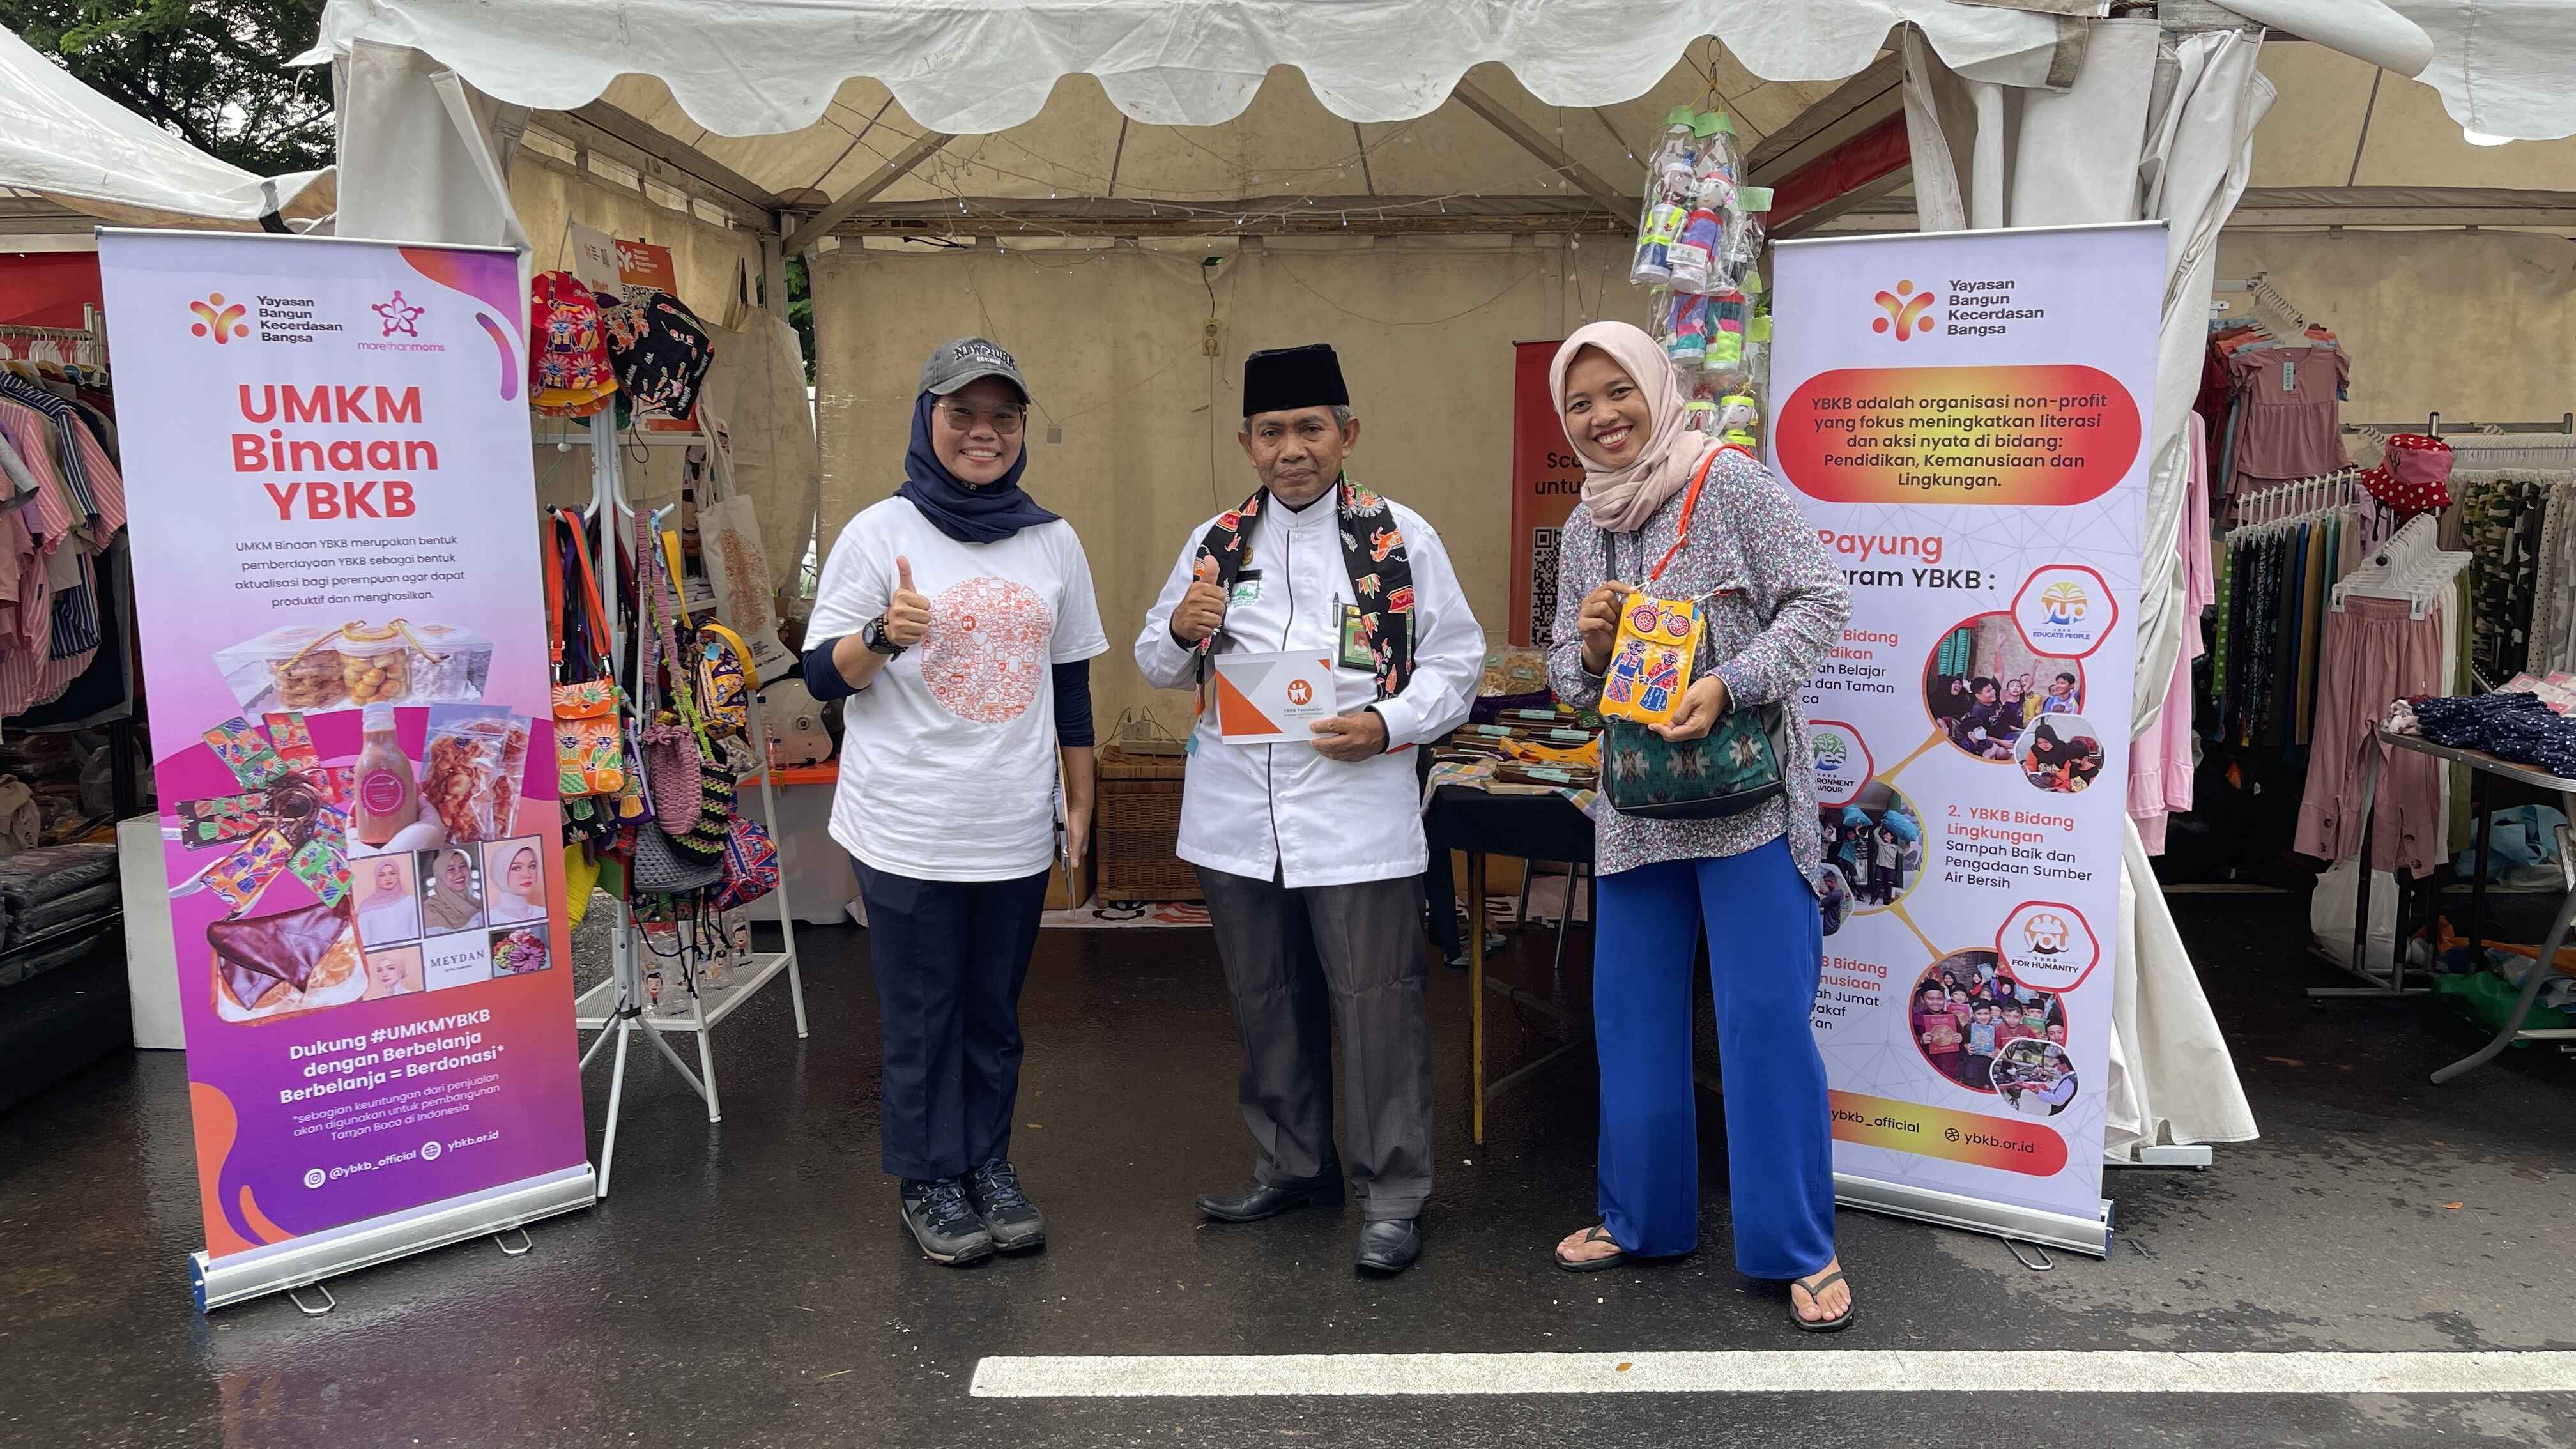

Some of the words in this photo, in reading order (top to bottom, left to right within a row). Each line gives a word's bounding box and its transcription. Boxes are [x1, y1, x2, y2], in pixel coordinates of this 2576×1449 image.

[1949, 279, 2015, 293] Yayasan
[257, 296, 314, 309] Yayasan
[1949, 293, 2010, 307] Bangun
[259, 308, 312, 320] Bangun
[1948, 307, 2044, 321] Kecerdasan
[261, 320, 342, 332] Kecerdasan
[1947, 323, 2005, 337] Bangsa
[261, 332, 313, 344] Bangsa
[358, 342, 445, 351] morethanmoms
[239, 385, 422, 424] UMKM
[1812, 397, 1852, 410] YBKB
[1857, 396, 1915, 410] adalah
[1919, 394, 2010, 411] organisasi
[2014, 393, 2108, 409] non-profit
[1814, 417, 1855, 433] yang
[1860, 415, 1905, 429] fokus
[1909, 414, 2035, 432] meningkatkan
[2040, 413, 2101, 428] literasi
[231, 429, 438, 472] Binaan
[1847, 434, 1878, 448] dan
[1883, 434, 1917, 448] aksi
[1920, 436, 1970, 451] nyata
[1974, 434, 1990, 448] di
[1995, 434, 2063, 452] bidang:
[1824, 454, 1920, 469] Pendidikan,
[1924, 454, 2045, 468] Kemanusiaan
[2050, 454, 2085, 468] dan
[1535, 477, 1586, 494] untu
[1898, 473, 2002, 490] Lingkungan.
[263, 480, 416, 521] YBKB
[236, 541, 272, 551] UMKM
[275, 540, 317, 550] Binaan
[320, 539, 348, 549] YBKB
[351, 537, 416, 549] merupakan
[418, 535, 457, 546] bentuk
[1818, 530, 1943, 565] Payung
[241, 556, 335, 572] pemberdayaan
[338, 556, 367, 567] YBKB
[369, 555, 414, 568] sebagai
[417, 553, 455, 564] bentuk
[235, 578, 299, 590] aktualisasi
[302, 576, 328, 589] bagi
[332, 574, 400, 588] perempuan
[402, 573, 428, 585] agar
[431, 571, 465, 585] dapat
[1841, 570, 1903, 586] ram
[1913, 568, 1981, 589] YBKB
[272, 595, 325, 609] produktif
[328, 593, 351, 604] dan
[353, 591, 434, 606] menghasilkan.
[2041, 601, 2088, 625] yup
[1843, 629, 1898, 647] Bidang
[1828, 646, 1873, 660] dikan
[1817, 663, 1835, 673] ah
[1839, 664, 1886, 679] Belajar
[1815, 678, 1841, 690] dan
[1846, 680, 1894, 693] Taman
[1802, 695, 1819, 704] ca
[1816, 778, 1855, 786] RONMENT
[1947, 804, 1961, 817] 2.
[1969, 807, 2011, 823] YBKB
[2014, 811, 2074, 831] Bidang
[1947, 823, 2044, 845] Lingkungan
[1946, 840, 2007, 857] Sampah
[2012, 845, 2043, 859] Baik
[2046, 850, 2076, 863] dan
[1945, 856, 2028, 875] Pengadaan
[2034, 864, 2092, 882] Sumber
[1945, 871, 1964, 885] Air
[1967, 874, 2011, 889] Bersih
[2024, 931, 2069, 953] you
[430, 949, 484, 967] MEYDAN
[1834, 958, 1887, 978] Bidang
[2032, 962, 2079, 973] HUMANITY
[1820, 975, 1881, 991] nusiaan
[1816, 989, 1831, 999] ah
[1835, 991, 1880, 1006] Jumat
[1809, 1016, 1832, 1029] r'an
[289, 1034, 367, 1061] Dukung
[371, 1009, 491, 1044] #UMKMYBKB
[303, 1050, 378, 1078] dengan
[383, 1031, 482, 1064] Berbelanja
[280, 1071, 386, 1104] Berbelanja
[390, 1070, 402, 1080] =
[355, 1090, 421, 1114] keuntungan
[423, 1083, 446, 1097] dari
[447, 1072, 499, 1096] penjualan
[294, 1124, 322, 1137] akan
[325, 1110, 387, 1131] digunakan
[388, 1103, 419, 1117] untuk
[421, 1085, 500, 1112] pembangunan
[331, 1126, 371, 1142] Taman
[374, 1118, 402, 1133] Baca
[405, 1114, 415, 1124] di
[417, 1103, 470, 1123] Indonesia
[1831, 1109, 1920, 1133] ybkb_official
[1965, 1131, 2034, 1154] ybkb.or.id
[329, 1149, 417, 1181] @ybkb_official
[448, 1130, 499, 1152] ybkb.or.id
